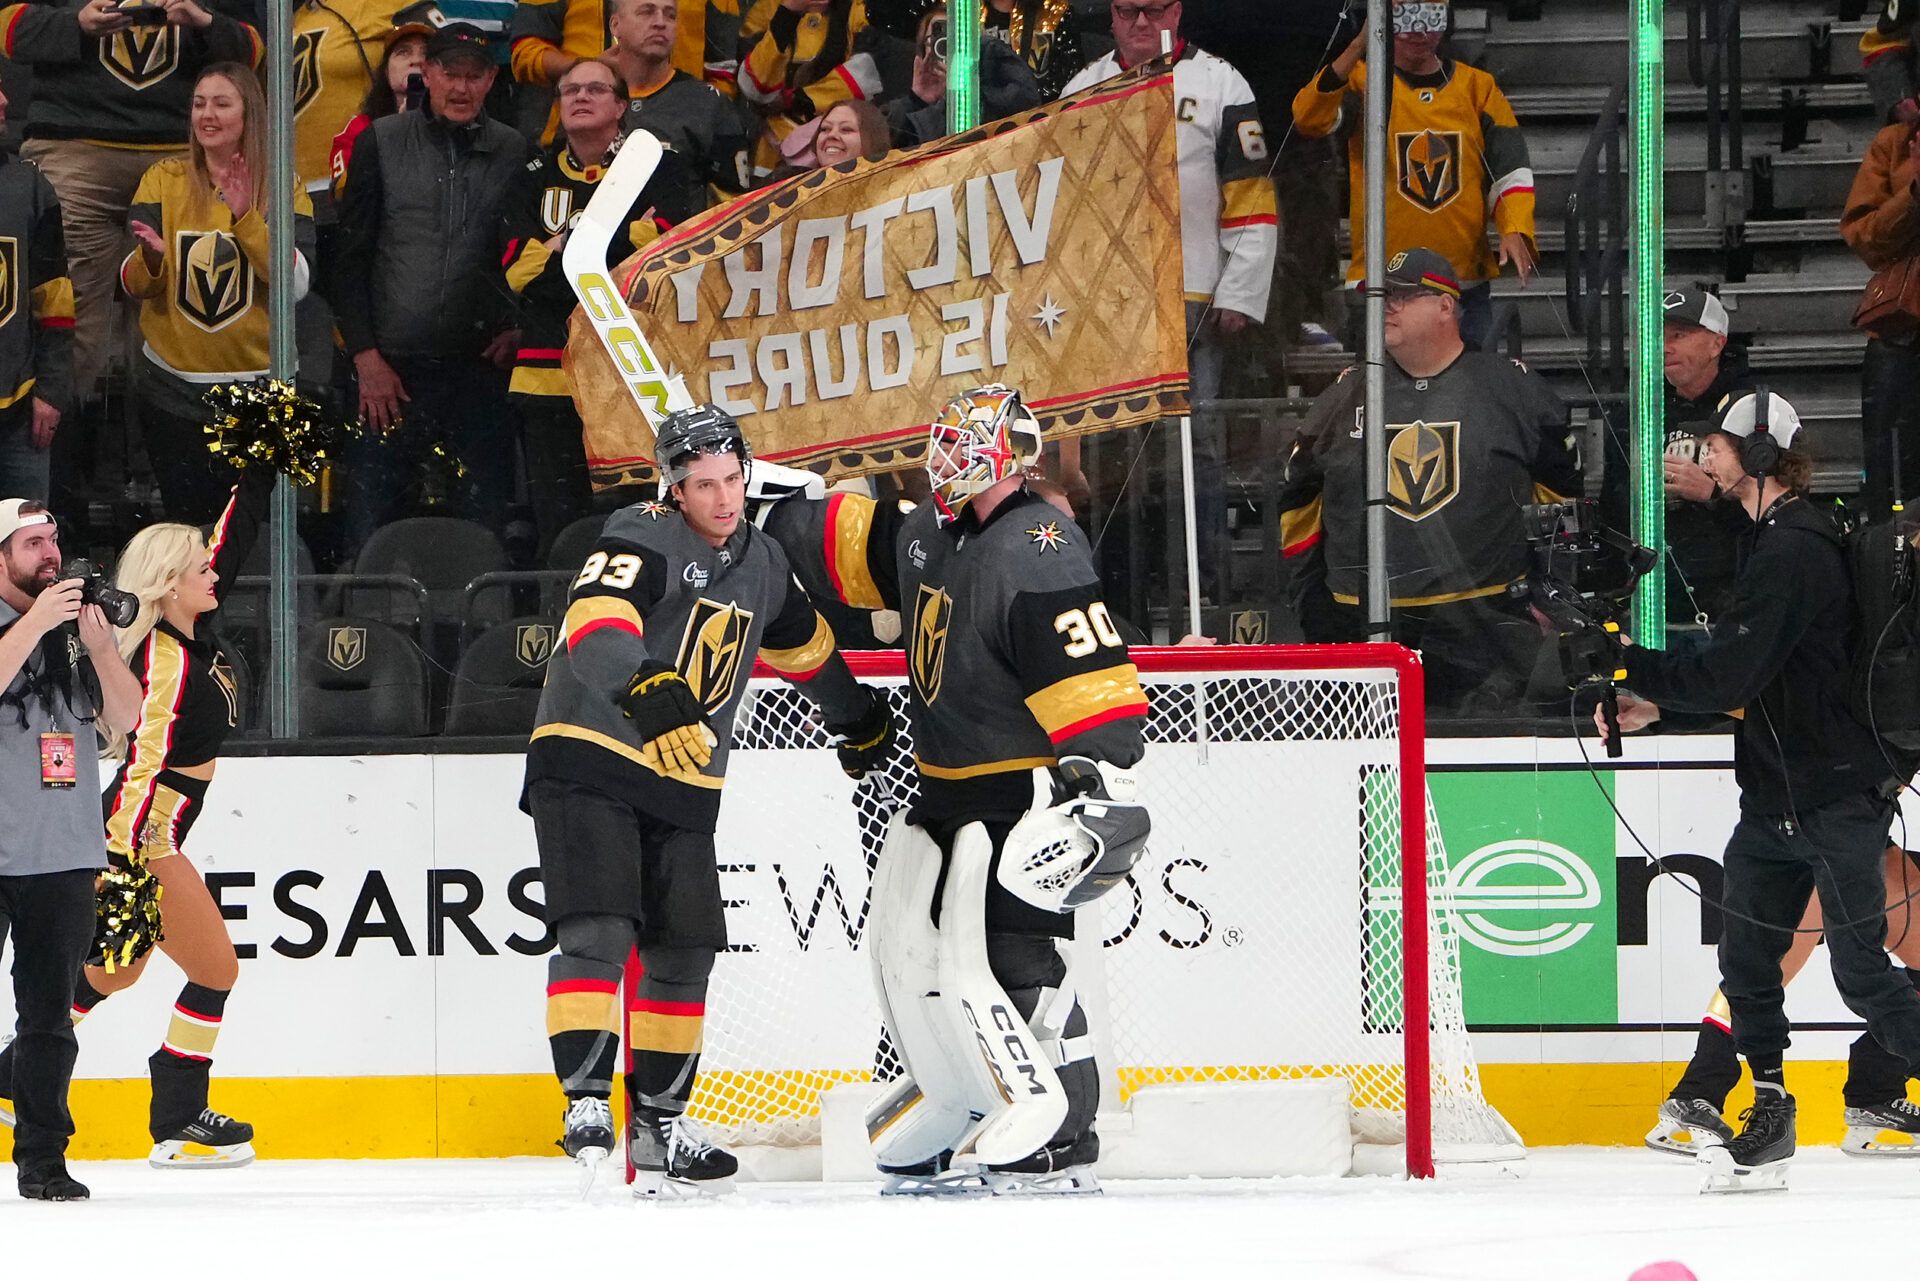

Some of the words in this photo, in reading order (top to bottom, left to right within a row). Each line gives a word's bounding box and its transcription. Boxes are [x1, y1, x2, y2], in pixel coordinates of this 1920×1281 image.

[1177, 97, 1197, 122] C
[573, 551, 643, 591] 93
[1054, 601, 1124, 659] 30
[991, 1004, 1048, 1095] CCM
